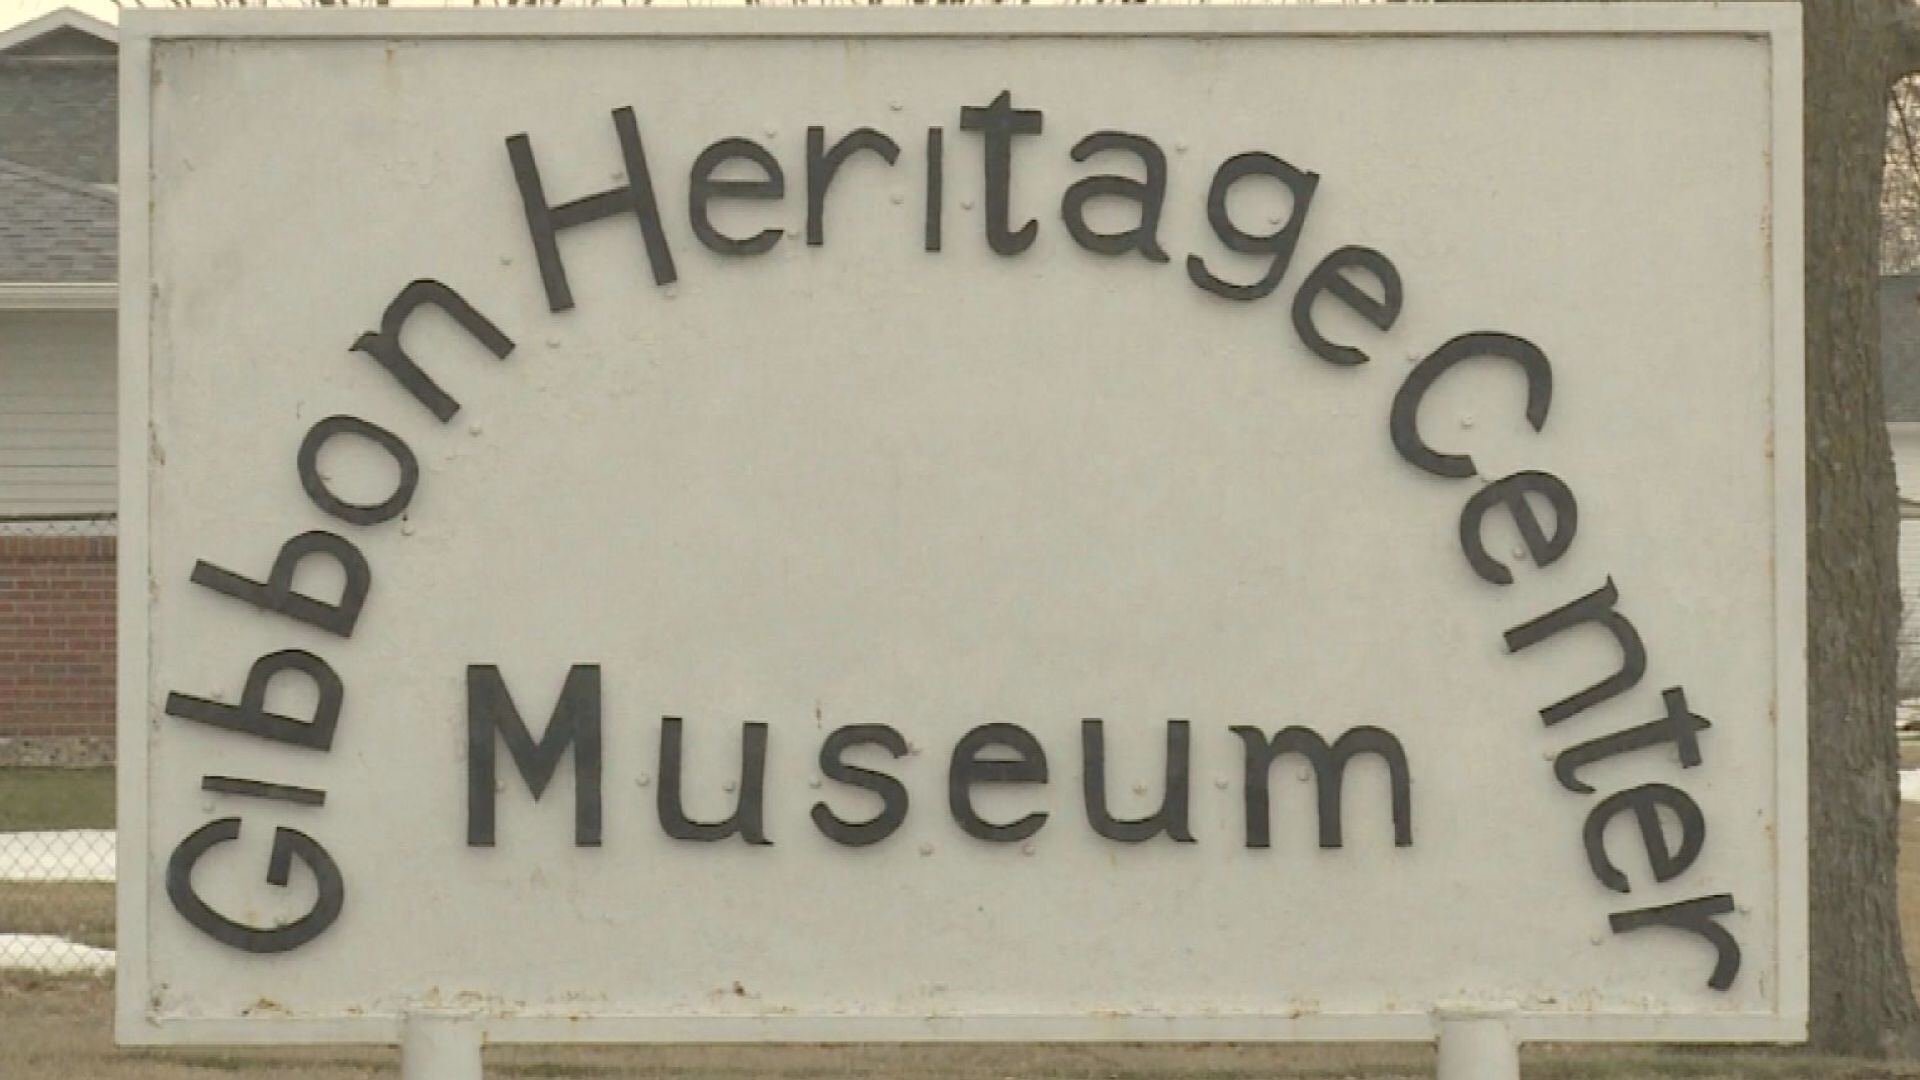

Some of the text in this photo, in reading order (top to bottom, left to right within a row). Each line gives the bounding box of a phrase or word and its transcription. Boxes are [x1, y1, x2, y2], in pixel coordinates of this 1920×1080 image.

[165, 89, 1742, 992] Gibbon Heritage Center
[466, 664, 1414, 850] Museum
